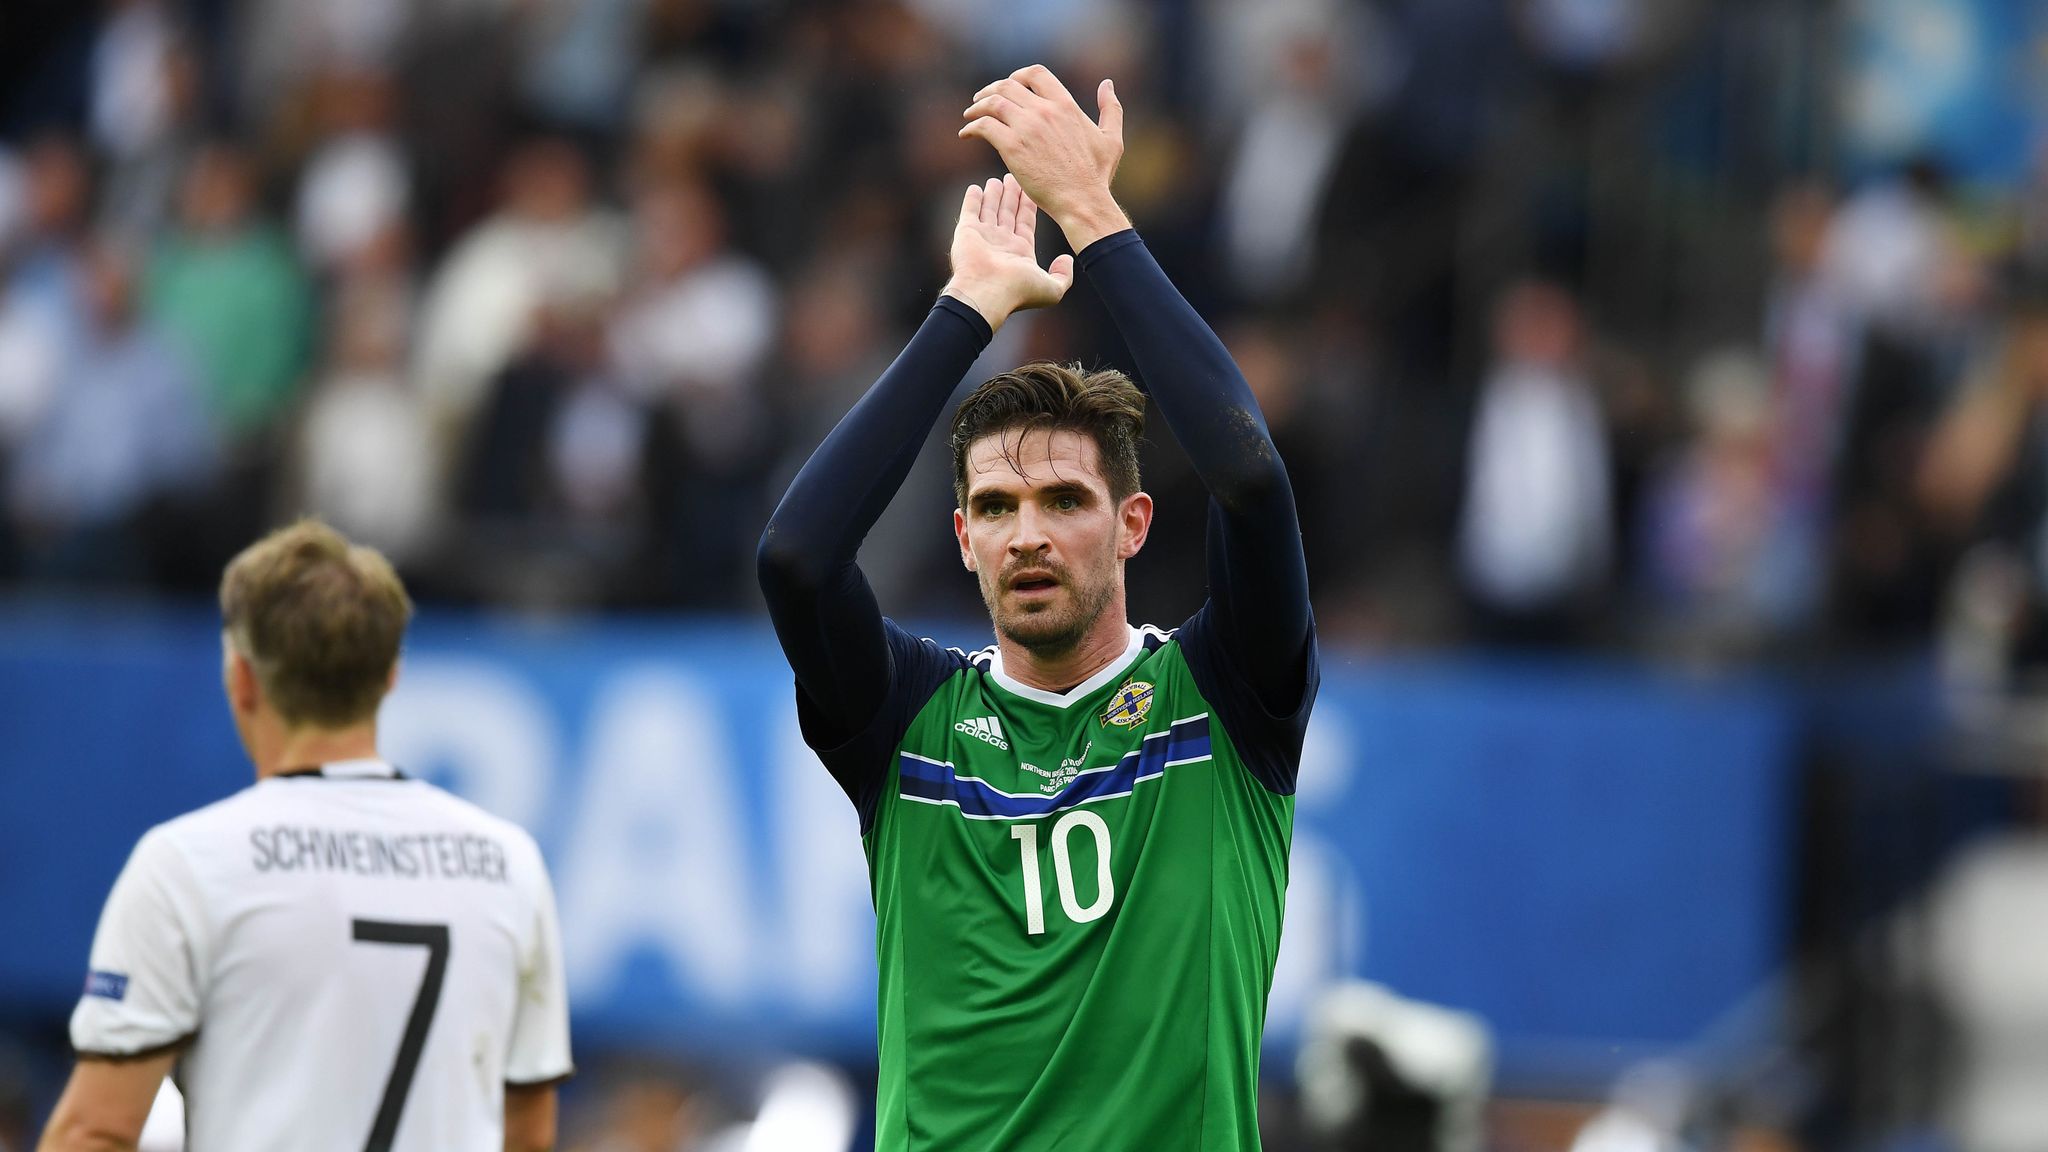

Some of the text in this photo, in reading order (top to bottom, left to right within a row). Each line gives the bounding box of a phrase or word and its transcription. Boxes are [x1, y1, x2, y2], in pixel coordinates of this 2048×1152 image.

[954, 722, 1009, 750] adidas
[1021, 762, 1052, 778] NORTHERN
[1065, 767, 1078, 775] 2016
[1040, 784, 1056, 793] PARC
[249, 824, 508, 884] SCHWEINSTEIGER
[1010, 809, 1115, 935] 10
[351, 918, 451, 1152] 7
